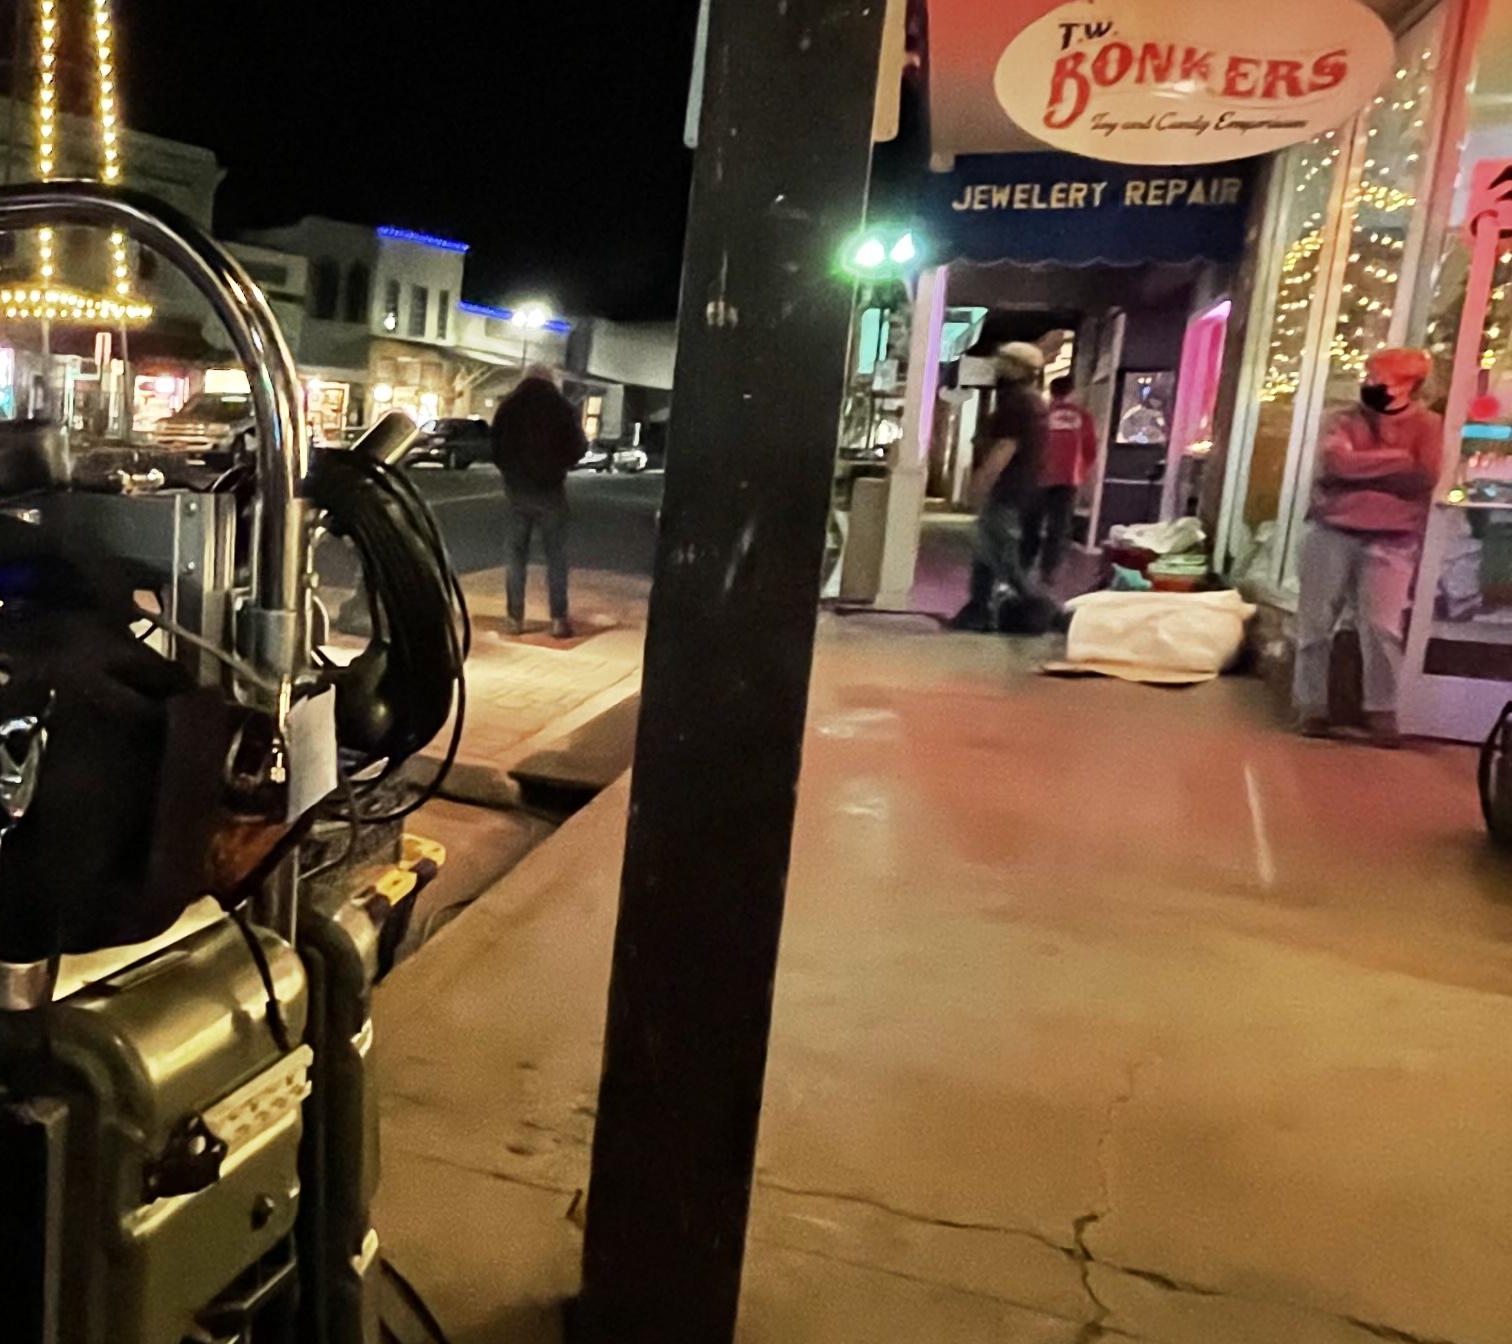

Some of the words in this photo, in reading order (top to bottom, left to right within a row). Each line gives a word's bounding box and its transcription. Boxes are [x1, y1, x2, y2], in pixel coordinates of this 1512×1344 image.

[1043, 42, 1348, 128] BONKERS
[951, 181, 1108, 212] JEWELERY
[1124, 178, 1244, 207] REPAIR
